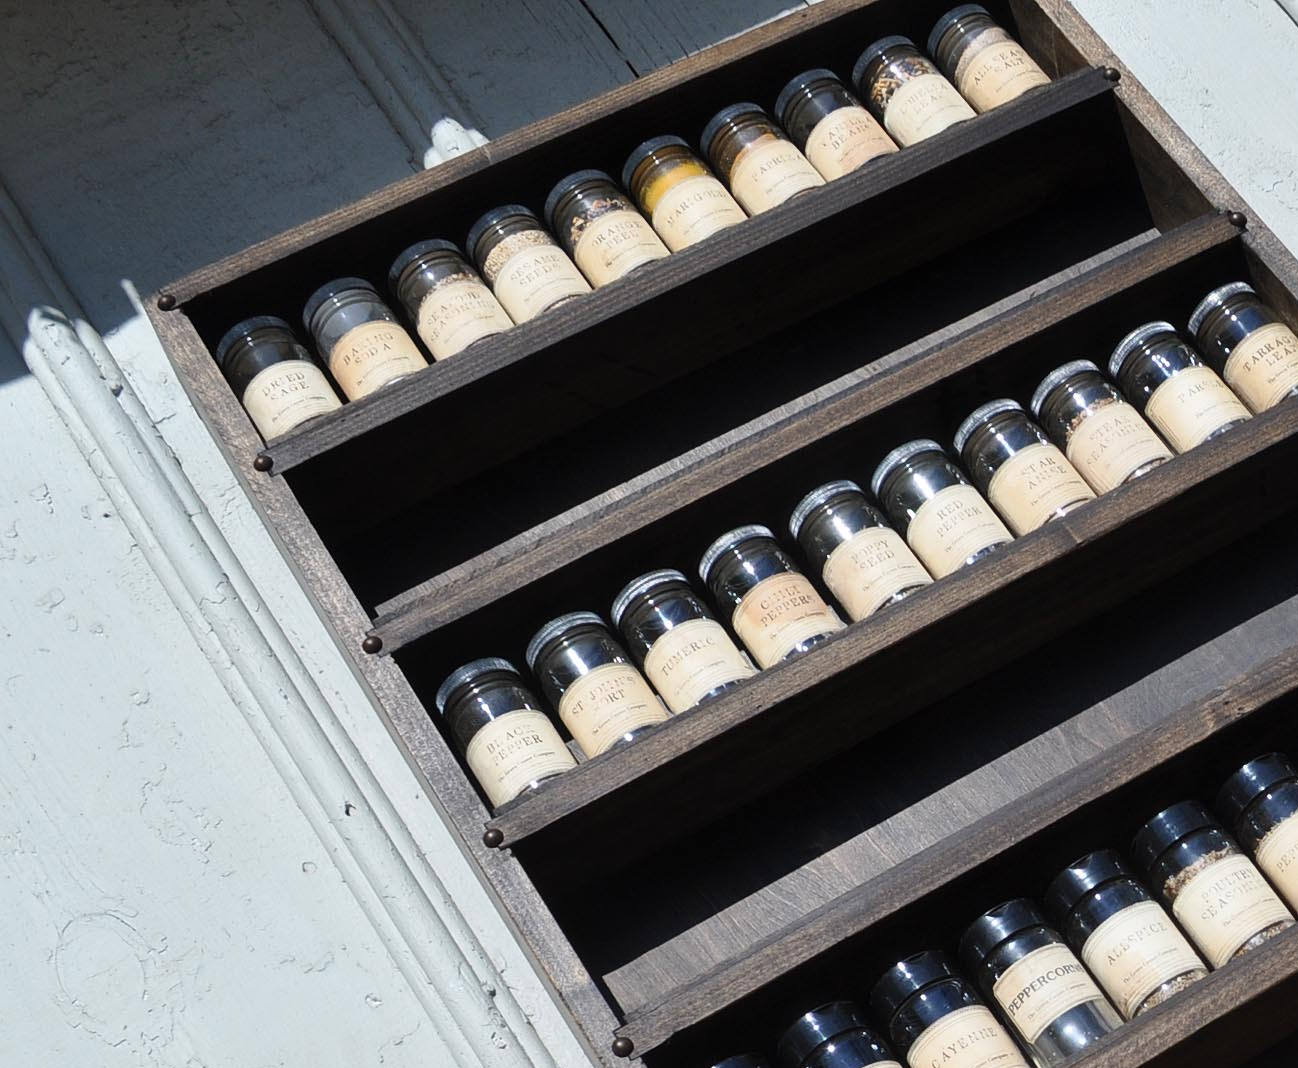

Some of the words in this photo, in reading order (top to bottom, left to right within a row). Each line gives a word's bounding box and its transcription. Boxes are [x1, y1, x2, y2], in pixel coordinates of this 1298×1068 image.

[354, 342, 392, 364] SODA
[936, 499, 964, 521] RED
[937, 507, 983, 538] PEPPER
[850, 538, 889, 565] POPPY
[859, 550, 895, 570] SEED
[660, 635, 716, 678] TUMERIC
[486, 723, 536, 755] BLACK
[493, 732, 544, 767] PEPPER
